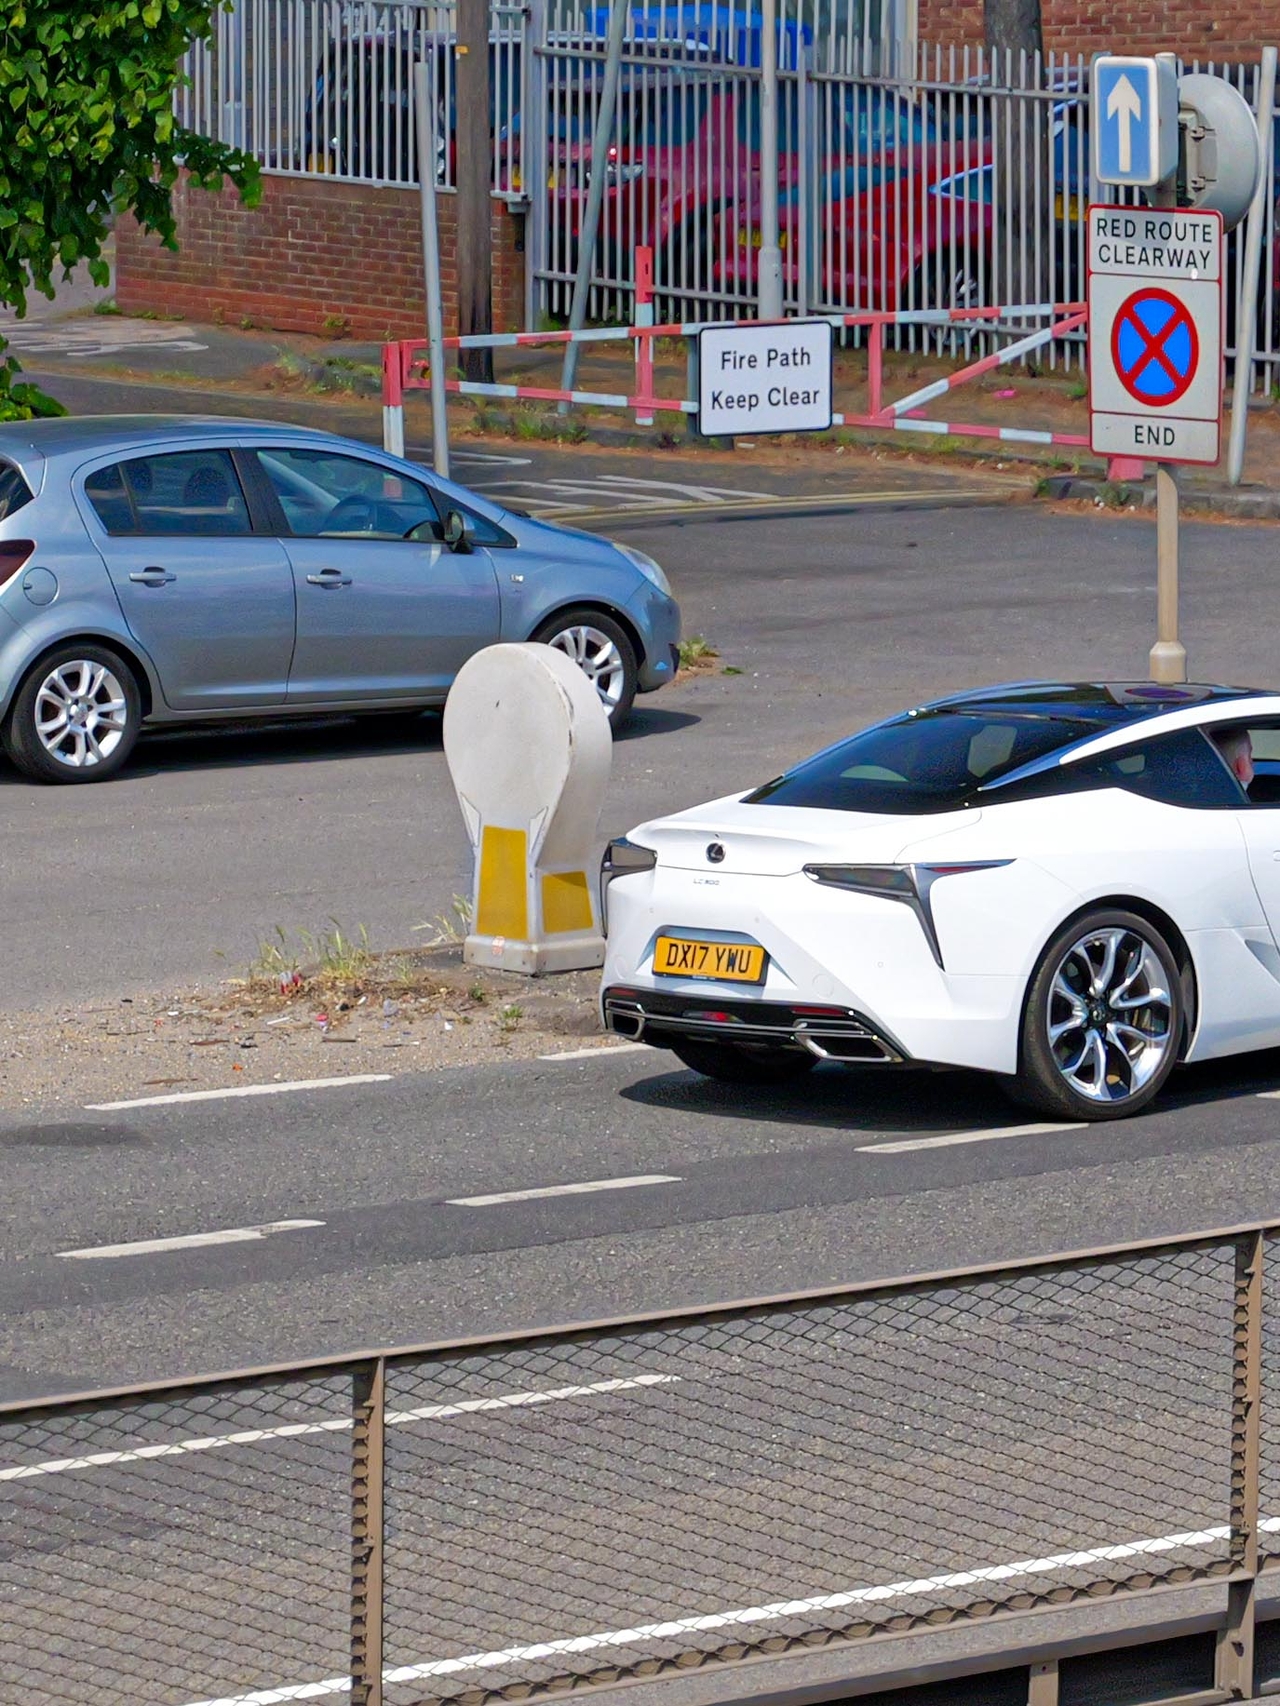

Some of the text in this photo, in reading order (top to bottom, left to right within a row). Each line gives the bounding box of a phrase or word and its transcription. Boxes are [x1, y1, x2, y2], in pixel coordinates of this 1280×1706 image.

[1096, 217, 1213, 243] RED ROUTE
[1098, 243, 1211, 270] CLEARWAY
[721, 346, 811, 370] Fire Path
[711, 386, 820, 412] Keep Clear
[1134, 424, 1175, 446] END
[666, 943, 752, 974] DX17 YWU
